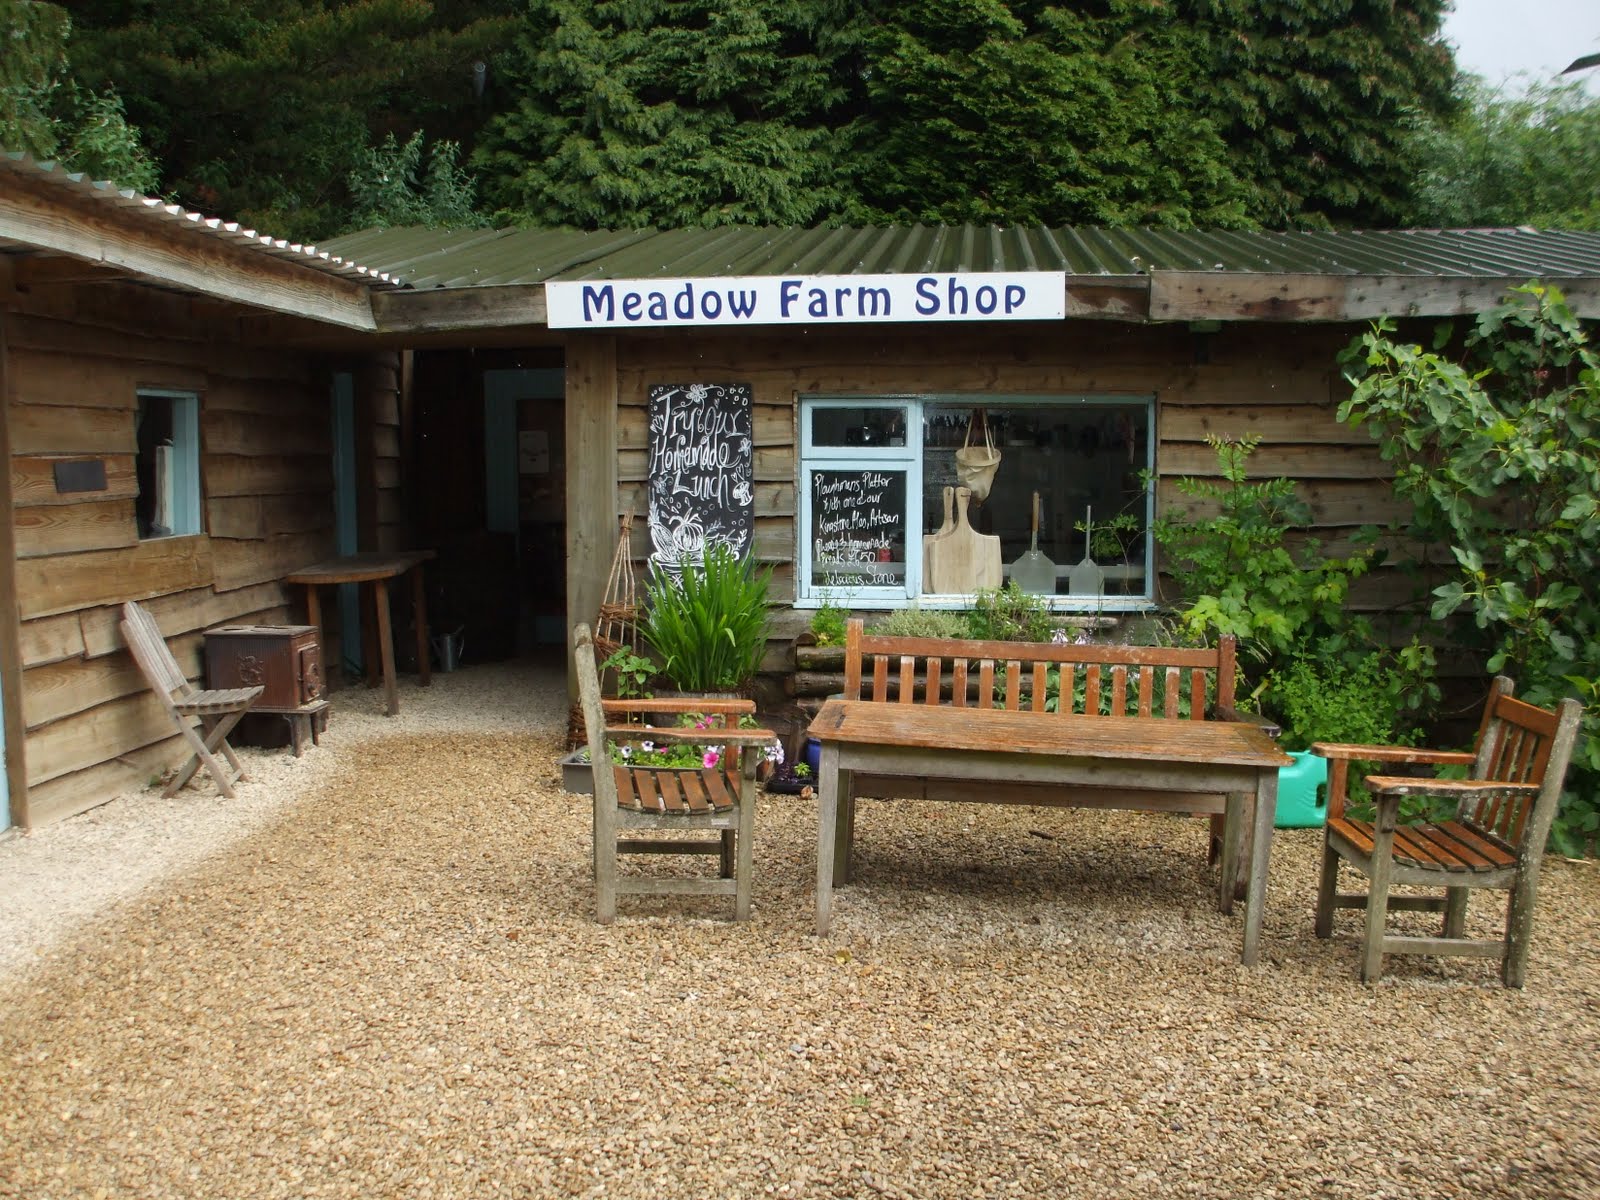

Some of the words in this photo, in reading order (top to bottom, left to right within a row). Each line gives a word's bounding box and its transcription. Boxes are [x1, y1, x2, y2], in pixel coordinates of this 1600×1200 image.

[582, 282, 758, 322] Meadow
[780, 279, 892, 318] Farm
[914, 277, 1028, 316] Shop
[656, 388, 700, 452] Try
[649, 434, 741, 477] Homemade
[672, 467, 736, 511] Lunch
[862, 471, 893, 489] Platter
[867, 491, 883, 503] our
[870, 508, 899, 527] Artisan
